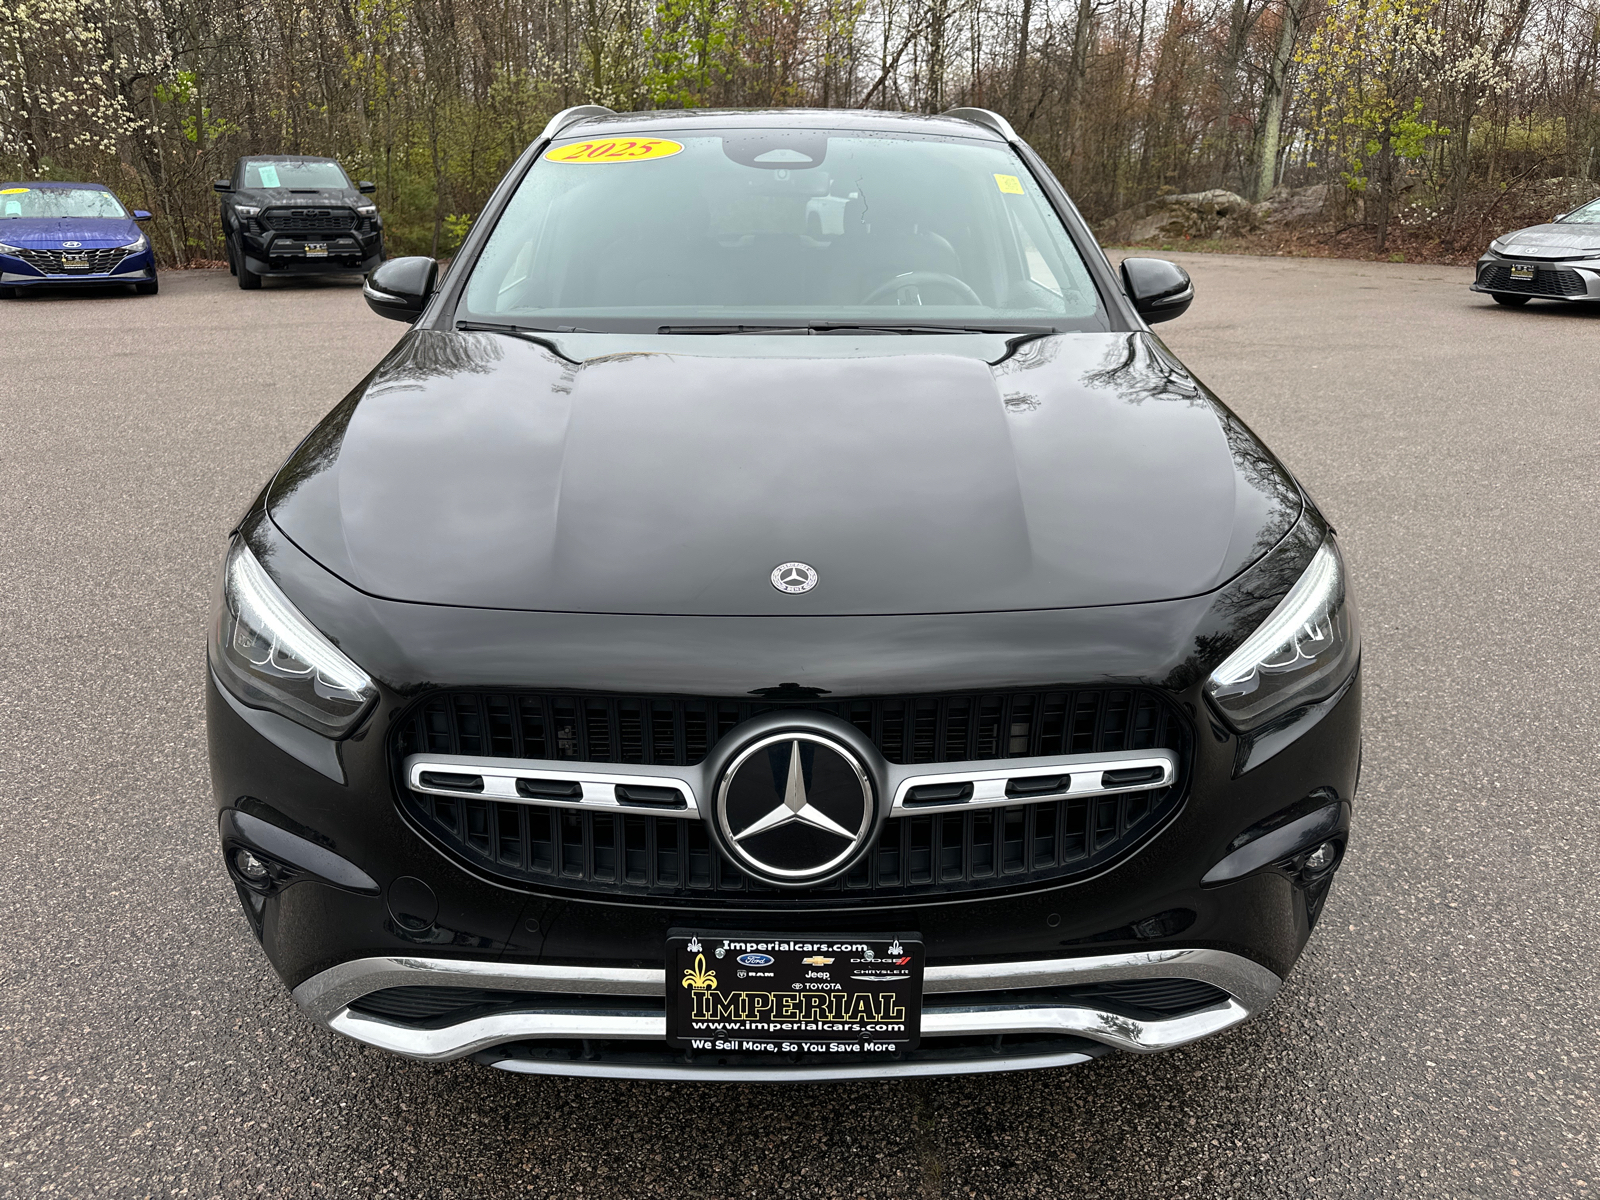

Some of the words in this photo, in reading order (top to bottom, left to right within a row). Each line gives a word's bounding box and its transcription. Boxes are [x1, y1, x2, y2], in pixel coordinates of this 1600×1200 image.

[561, 140, 662, 161] 2025
[722, 940, 868, 953] Imperialcars.com
[744, 955, 766, 964] Ford
[804, 970, 830, 979] Jeep
[691, 989, 906, 1022] IMPERIAL
[691, 1020, 905, 1032] www.imperialcars.com
[691, 1039, 713, 1049] We
[715, 1040, 739, 1050] Sell
[742, 1041, 778, 1053] More,
[781, 1042, 798, 1052] So
[801, 1042, 826, 1052] You
[829, 1042, 860, 1052] Save
[863, 1042, 896, 1052] More
